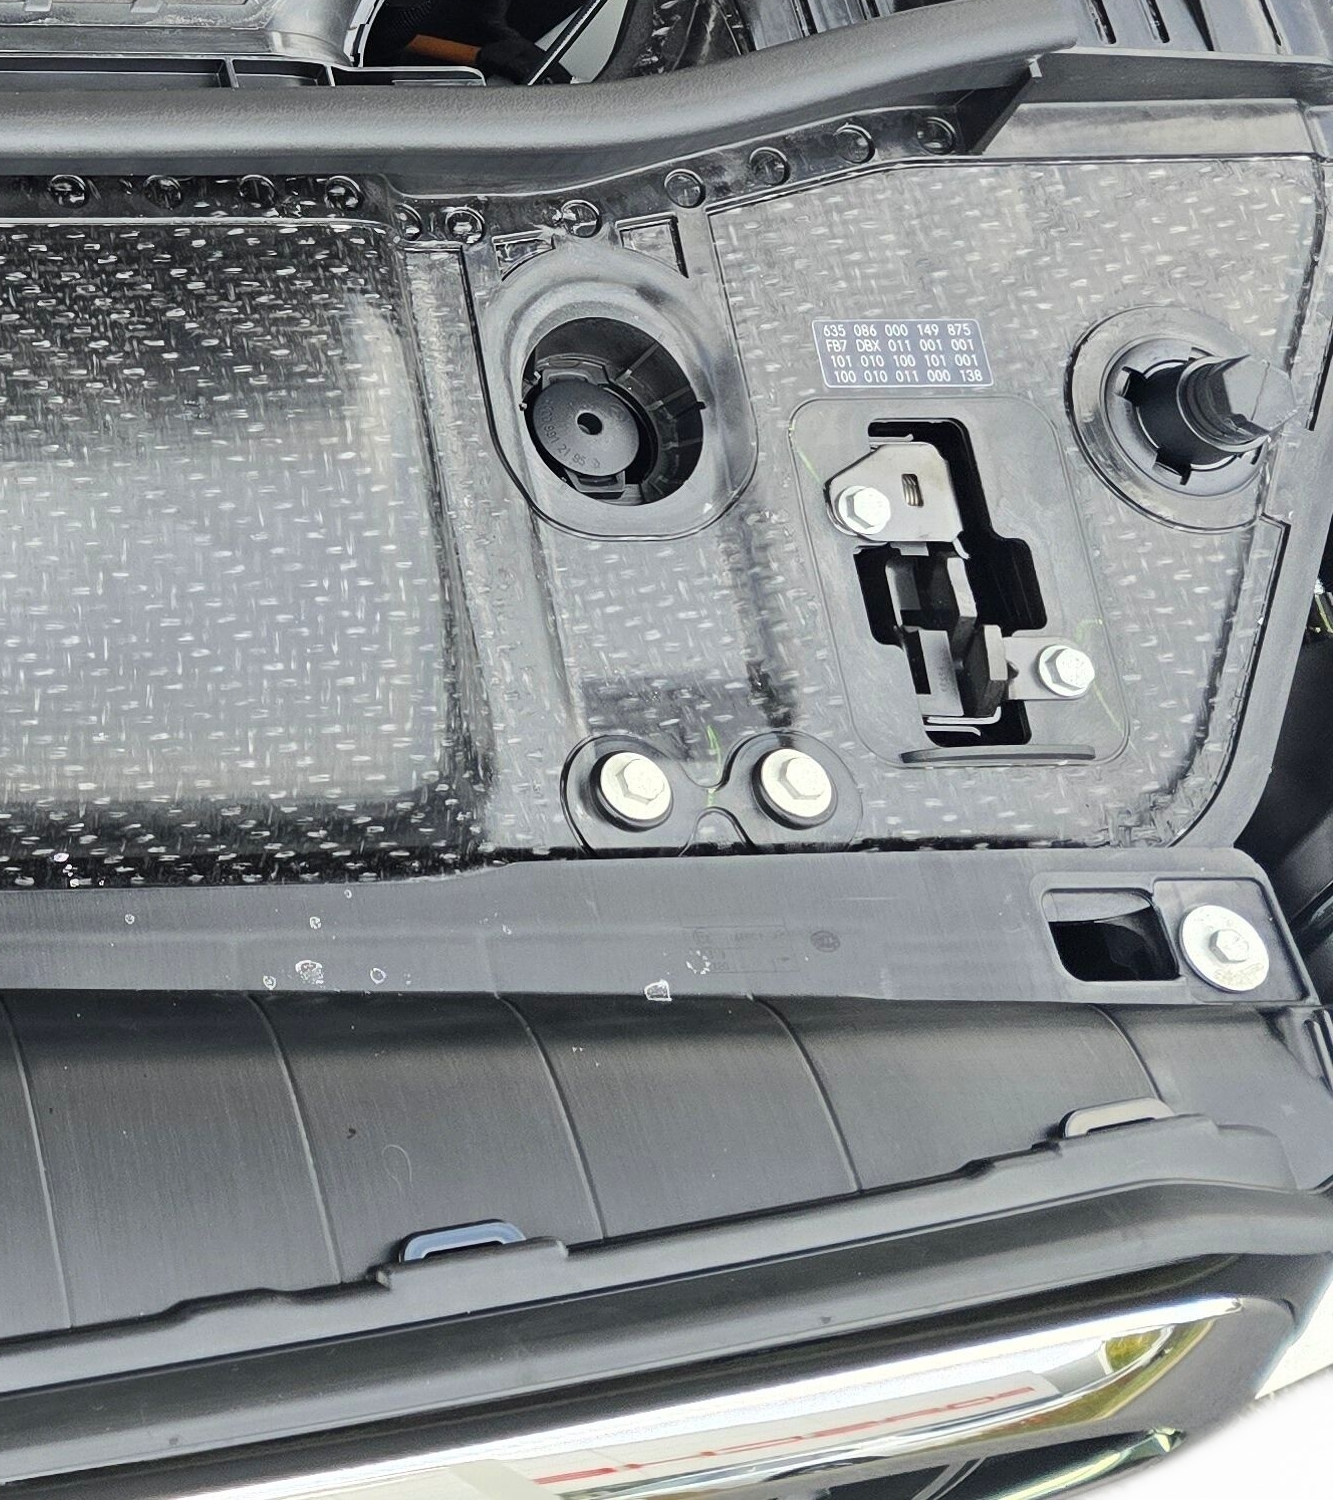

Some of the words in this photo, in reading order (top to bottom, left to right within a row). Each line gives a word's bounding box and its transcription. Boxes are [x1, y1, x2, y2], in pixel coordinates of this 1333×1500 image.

[823, 323, 846, 337] 635
[853, 323, 878, 337] 086
[884, 323, 909, 337] 000
[916, 323, 940, 337] 149
[947, 323, 972, 337] 875
[825, 339, 847, 352] FB7
[855, 339, 882, 352] DBX
[887, 339, 912, 352] 011
[919, 339, 943, 352] 001
[950, 339, 975, 352] 001
[830, 354, 852, 368] 101
[860, 354, 885, 368] 010
[892, 354, 916, 368] 100
[924, 354, 947, 368] 101
[954, 354, 979, 368] 001
[834, 369, 857, 384] 100
[863, 369, 889, 384] 010
[895, 369, 920, 384] 011
[926, 369, 952, 384] 000
[959, 369, 983, 384] 138
